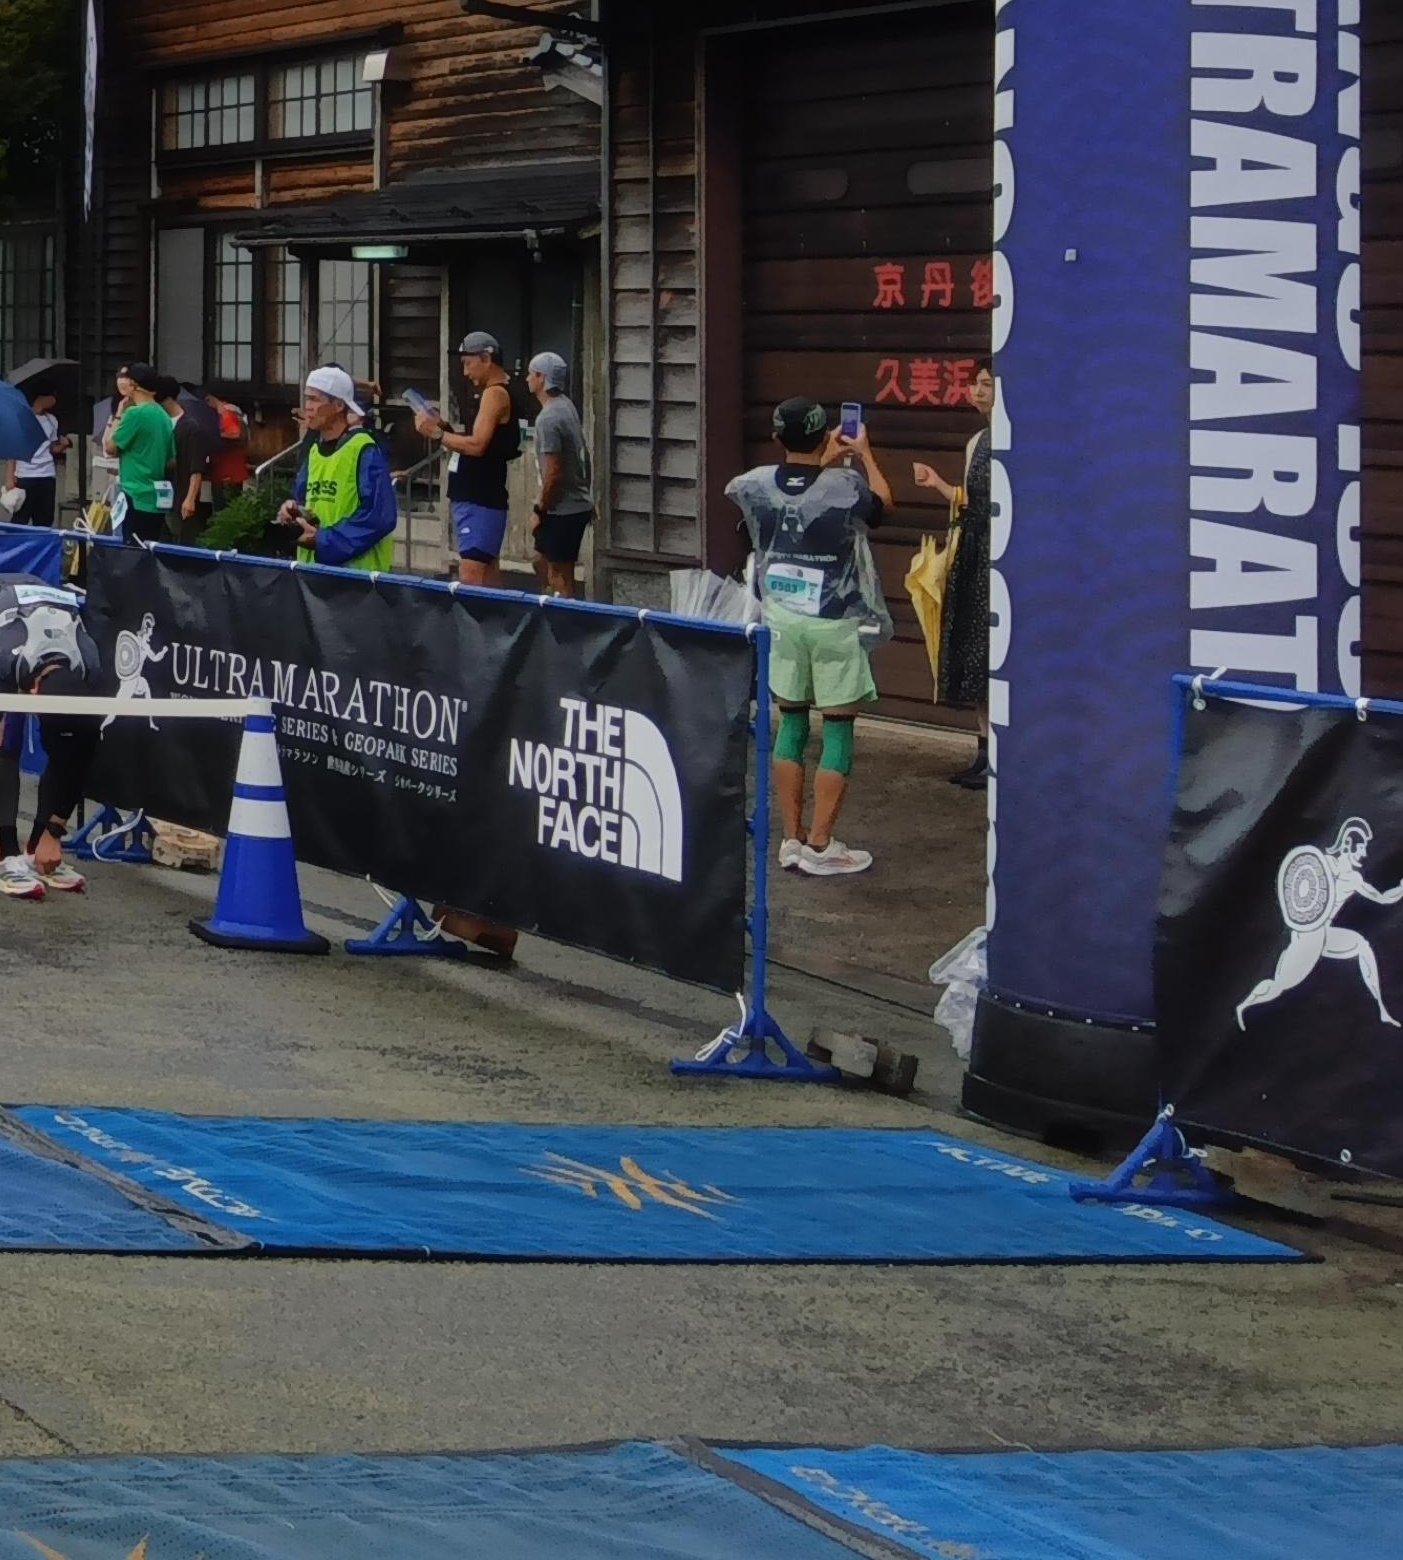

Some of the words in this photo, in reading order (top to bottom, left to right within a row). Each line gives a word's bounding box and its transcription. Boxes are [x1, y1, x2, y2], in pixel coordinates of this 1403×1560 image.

[281, 716, 328, 743] SERIES
[411, 747, 458, 777] SERIES
[559, 697, 623, 758] THE
[508, 737, 621, 811] NORTH
[537, 795, 619, 864] FACE
